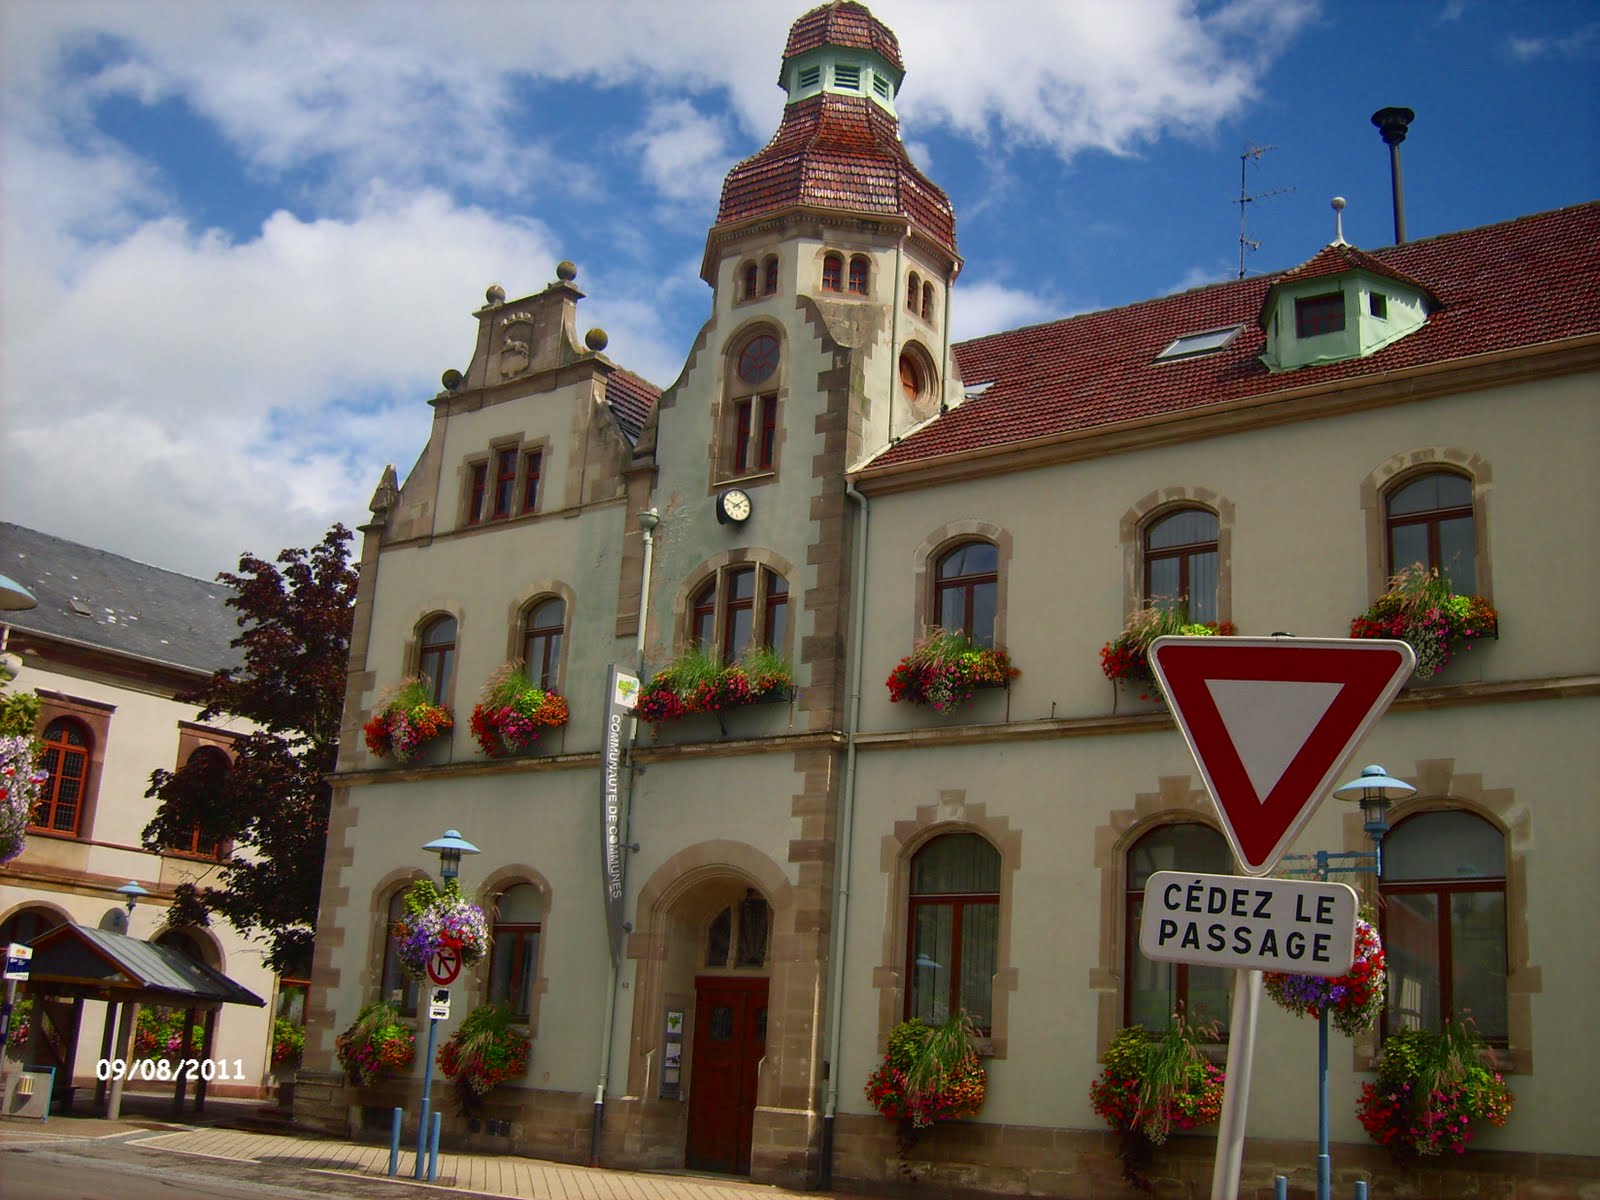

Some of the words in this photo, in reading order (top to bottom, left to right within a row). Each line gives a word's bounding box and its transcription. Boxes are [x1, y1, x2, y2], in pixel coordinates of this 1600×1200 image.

[608, 806, 618, 823] DE
[608, 825, 622, 899] COMMUNES
[1163, 879, 1273, 919] CÉDEZ
[1295, 894, 1335, 925] LE
[1158, 919, 1331, 963] PASSAGE
